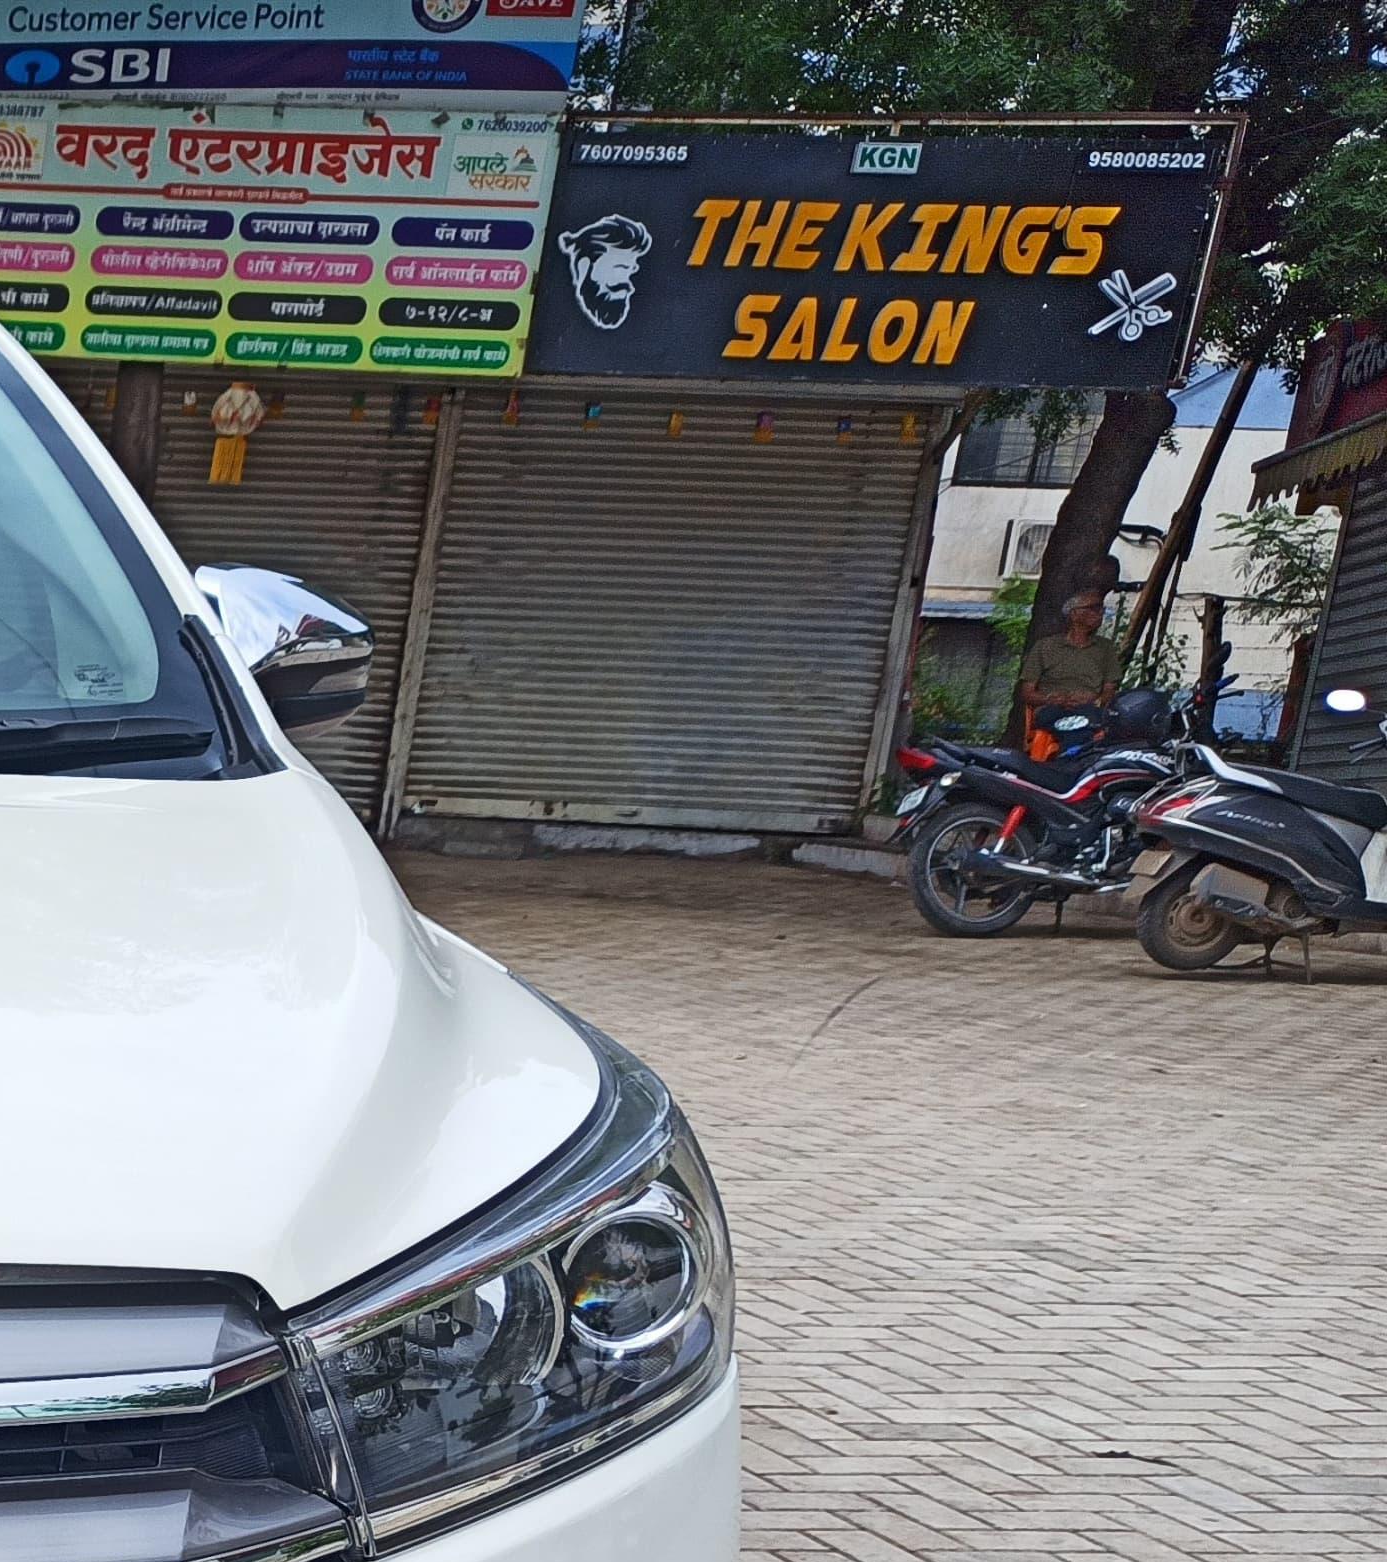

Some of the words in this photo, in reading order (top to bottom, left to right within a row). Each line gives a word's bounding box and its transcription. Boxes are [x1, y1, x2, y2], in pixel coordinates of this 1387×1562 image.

[8, 5, 141, 33] Customer
[147, 4, 248, 30] Service
[254, 3, 325, 29] Point
[69, 48, 171, 84] SBI
[345, 70, 379, 81] STATE
[382, 70, 412, 81] BANK
[415, 71, 432, 81] OF
[435, 71, 467, 81] INDIA
[55, 124, 157, 180] वरद
[168, 112, 444, 184] एंटरप्राइजेस
[579, 143, 688, 162] 7607095365
[858, 143, 919, 169] KGN
[1089, 151, 1206, 169] 9580085202
[453, 152, 511, 175] आपले
[467, 173, 532, 192] सरकार
[435, 226, 456, 242] पॅन
[460, 224, 492, 243] कार्ड
[686, 199, 841, 269] THE
[833, 202, 1122, 275] KING'S
[721, 294, 976, 366] SALON
